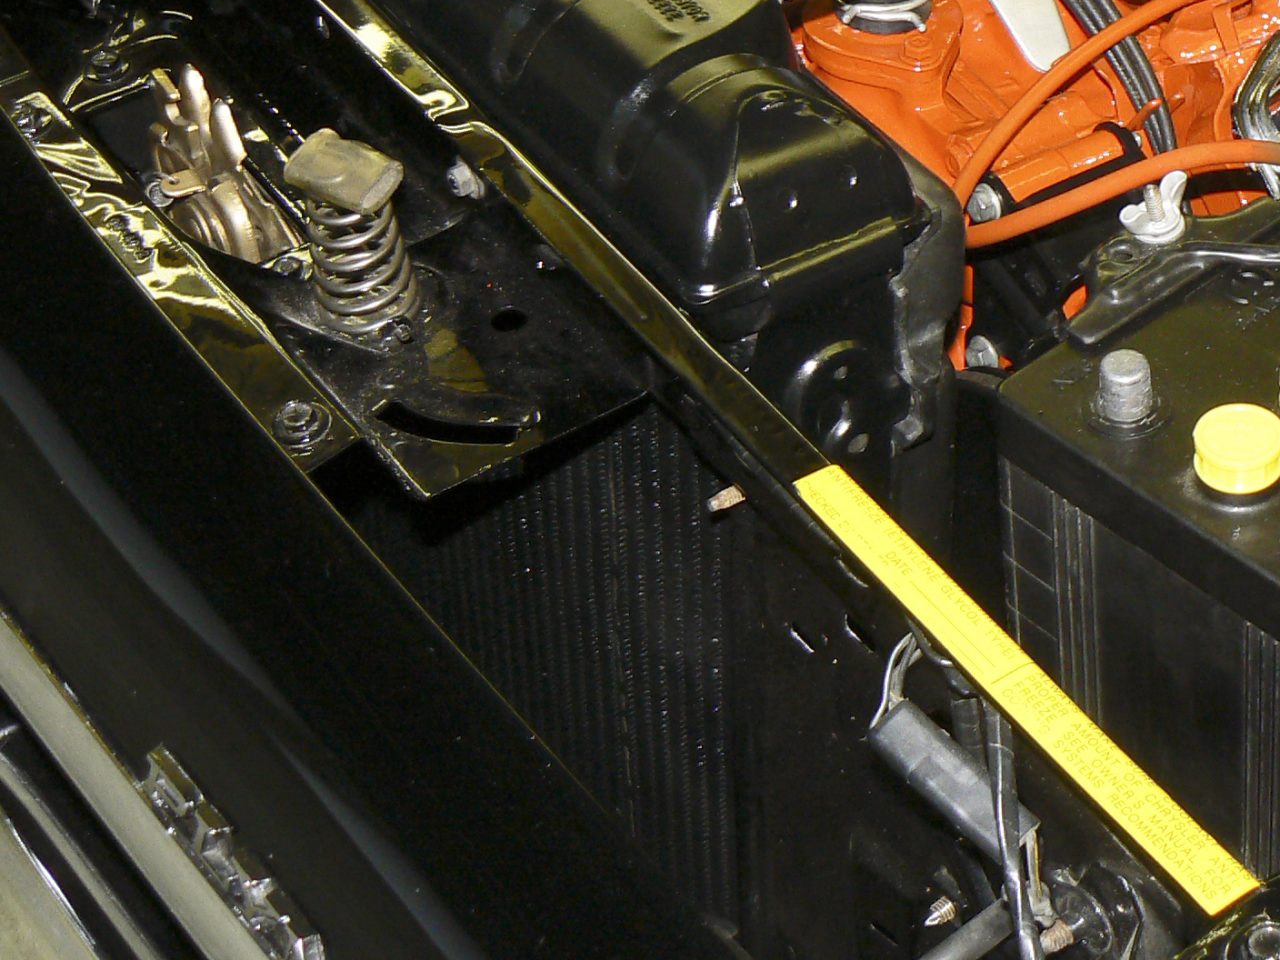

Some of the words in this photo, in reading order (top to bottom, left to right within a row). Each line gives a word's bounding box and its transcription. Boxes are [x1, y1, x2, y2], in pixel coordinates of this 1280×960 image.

[884, 549, 912, 576] DATE
[939, 583, 984, 626] GLYCOL
[1012, 680, 1057, 723] FREEZE
[1061, 729, 1089, 754] SEE
[1146, 813, 1199, 863] MANUAL
[1202, 868, 1232, 894] FOR
[1024, 674, 1069, 717] PROPER
[1070, 720, 1120, 767] AMOUNT
[1121, 771, 1142, 789] OF
[1143, 791, 1205, 850] CHRYSLER
[1052, 739, 1105, 788] SYSTEMS
[1105, 792, 1218, 901] RECOMMENDATIONS
